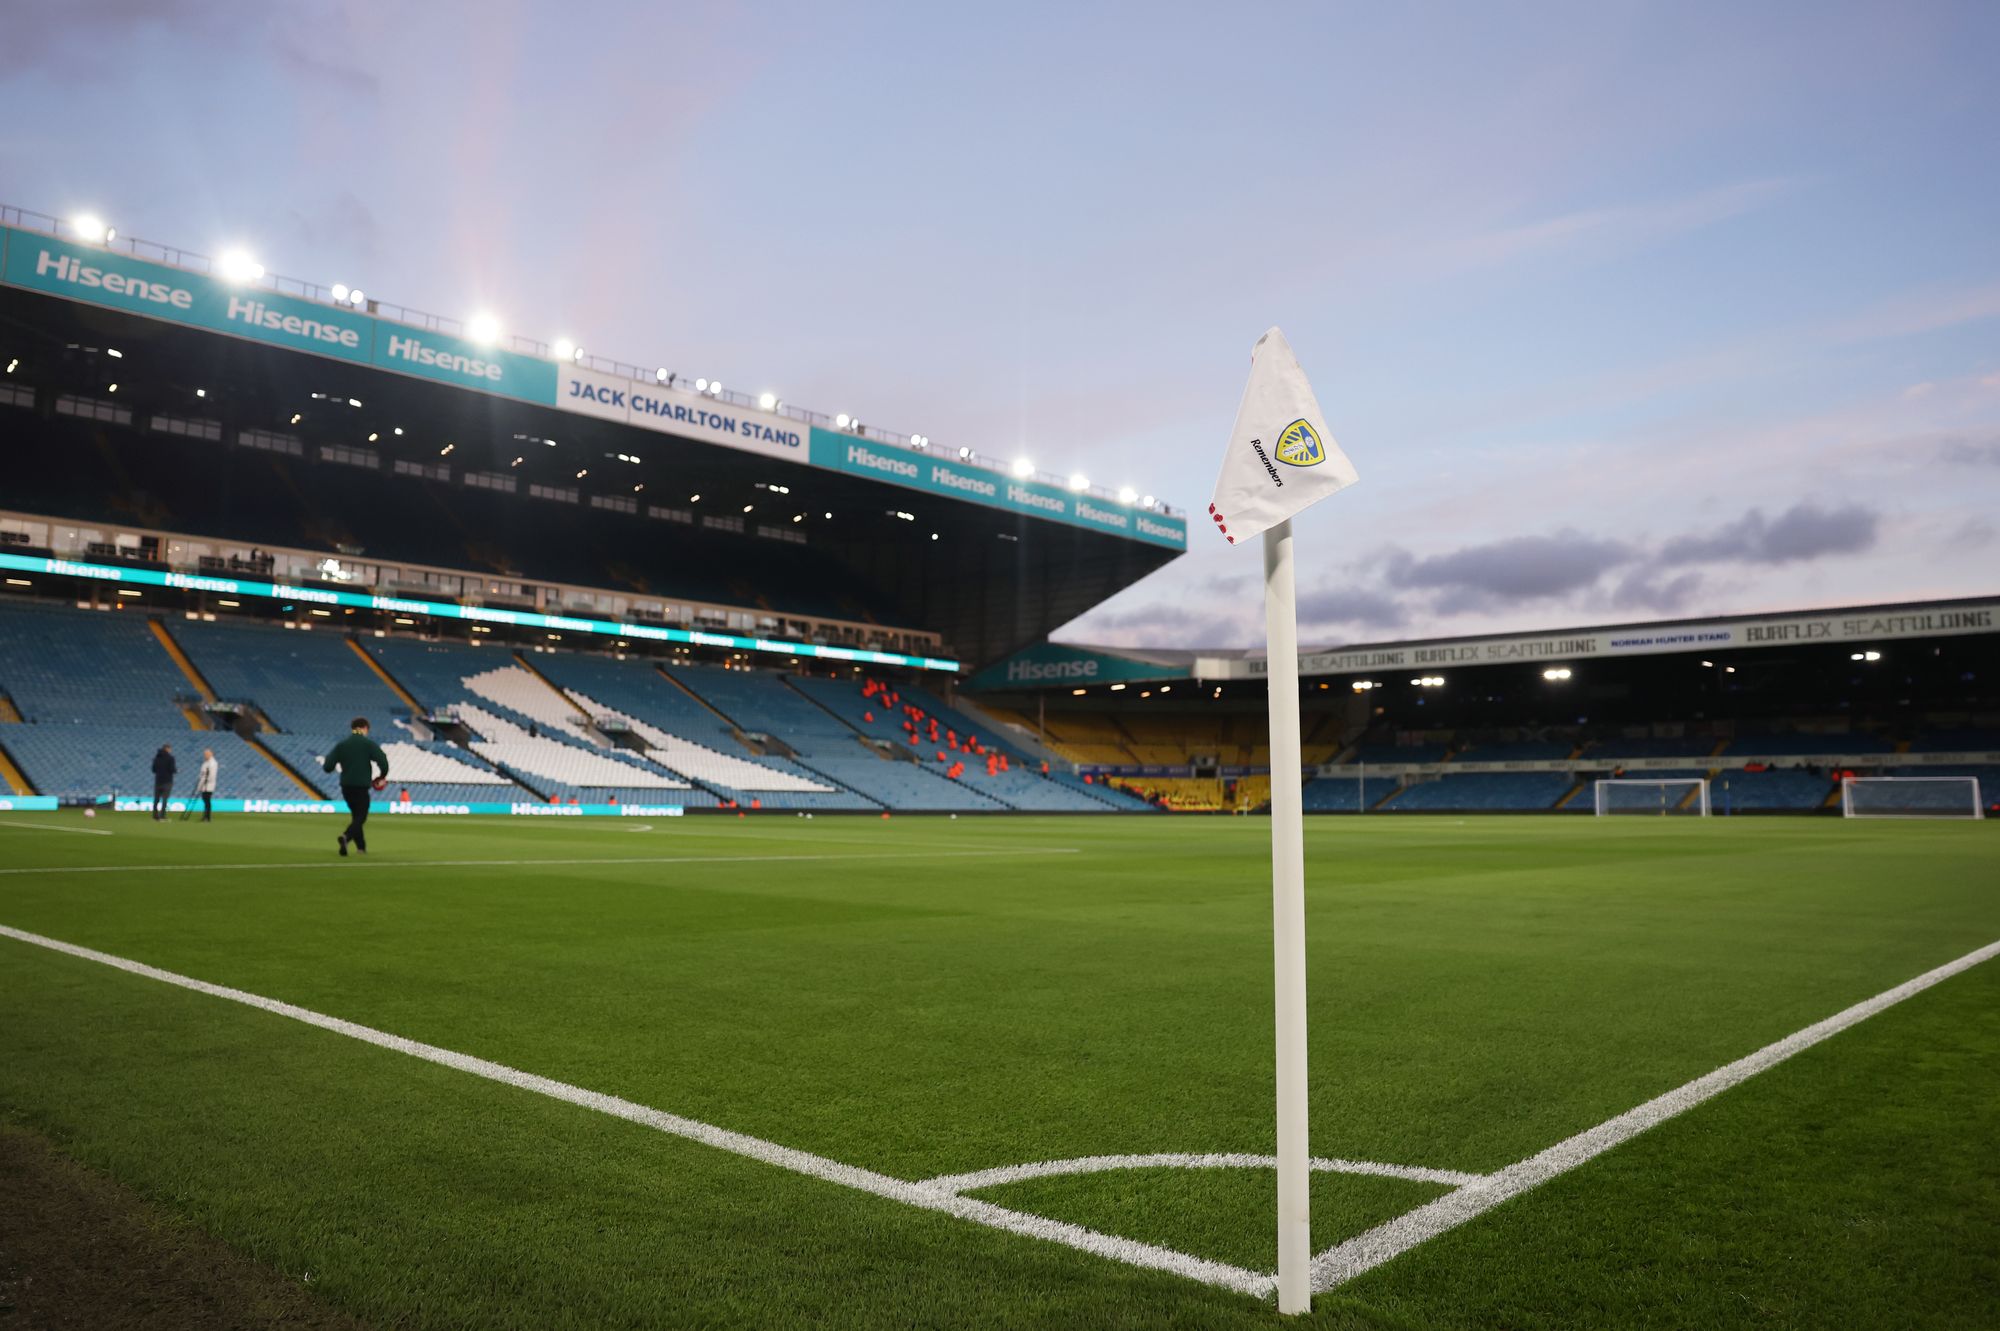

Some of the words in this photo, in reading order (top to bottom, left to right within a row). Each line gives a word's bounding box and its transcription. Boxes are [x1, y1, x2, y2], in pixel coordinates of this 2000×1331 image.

[36, 250, 193, 309] Hisense
[227, 297, 359, 347] Hisense
[388, 335, 503, 380] Hisense
[569, 380, 626, 408] JACK
[631, 394, 736, 434] CHARLTON
[741, 421, 801, 448] STAND
[847, 446, 918, 478] Hisense
[1250, 438, 1284, 487] Remembers
[932, 466, 996, 497] Hisense
[1007, 485, 1065, 513] Hisense
[1076, 501, 1128, 528] Hisense
[1136, 517, 1185, 542] Hisense
[46, 558, 122, 580] Hisense
[165, 572, 239, 593] Hisense
[271, 584, 338, 604] Hisense
[372, 596, 430, 614] Hisense
[460, 606, 516, 624] Hisense
[1746, 621, 1832, 642] BURFLEX
[1843, 611, 1992, 637] SCAFFOLDING
[1611, 638, 1653, 648] NORMAN
[1655, 634, 1695, 645] HUNTER
[1697, 631, 1731, 642] STAND
[1008, 659, 1099, 681] Hisense
